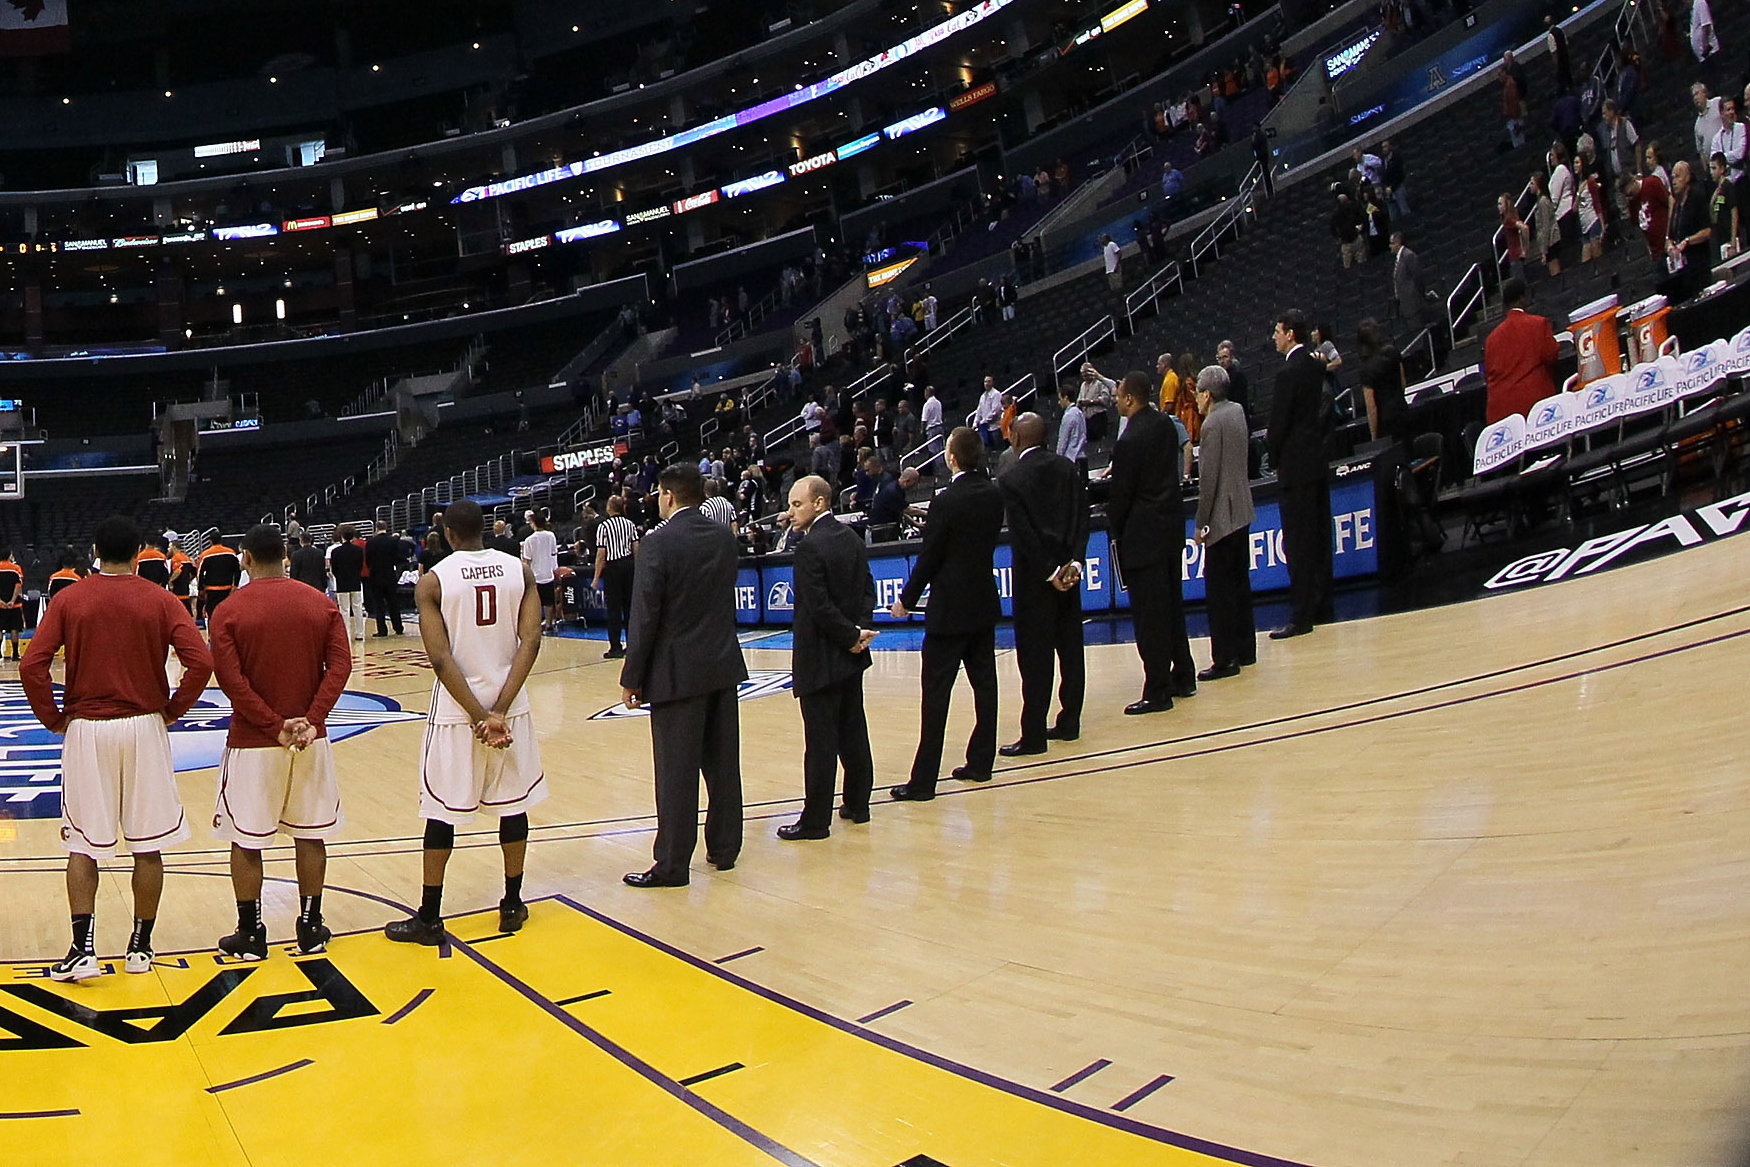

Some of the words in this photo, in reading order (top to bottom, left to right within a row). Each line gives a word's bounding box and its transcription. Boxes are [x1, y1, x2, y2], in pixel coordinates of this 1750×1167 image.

[488, 175, 535, 196] PACIFIC
[535, 166, 563, 184] LIFE
[584, 138, 676, 170] TOURNAMENT
[788, 151, 837, 177] TOYOTA
[508, 236, 548, 255] STAPLES
[1577, 329, 1595, 358] G
[1639, 323, 1651, 345] G
[1676, 370, 1709, 394] PACIFIC
[1623, 392, 1656, 412] PACIFIC
[1656, 387, 1674, 404] LIFE
[1574, 406, 1607, 427] PACIFIC
[1524, 426, 1557, 446] PACIFIC
[1556, 419, 1573, 437] LIFE
[552, 445, 615, 472] STAPLES
[1350, 461, 1373, 472] ANC
[1475, 447, 1508, 471] PACIFIC
[1507, 438, 1523, 458] LIFE
[460, 564, 505, 581] CAPERS
[563, 586, 575, 605] nike
